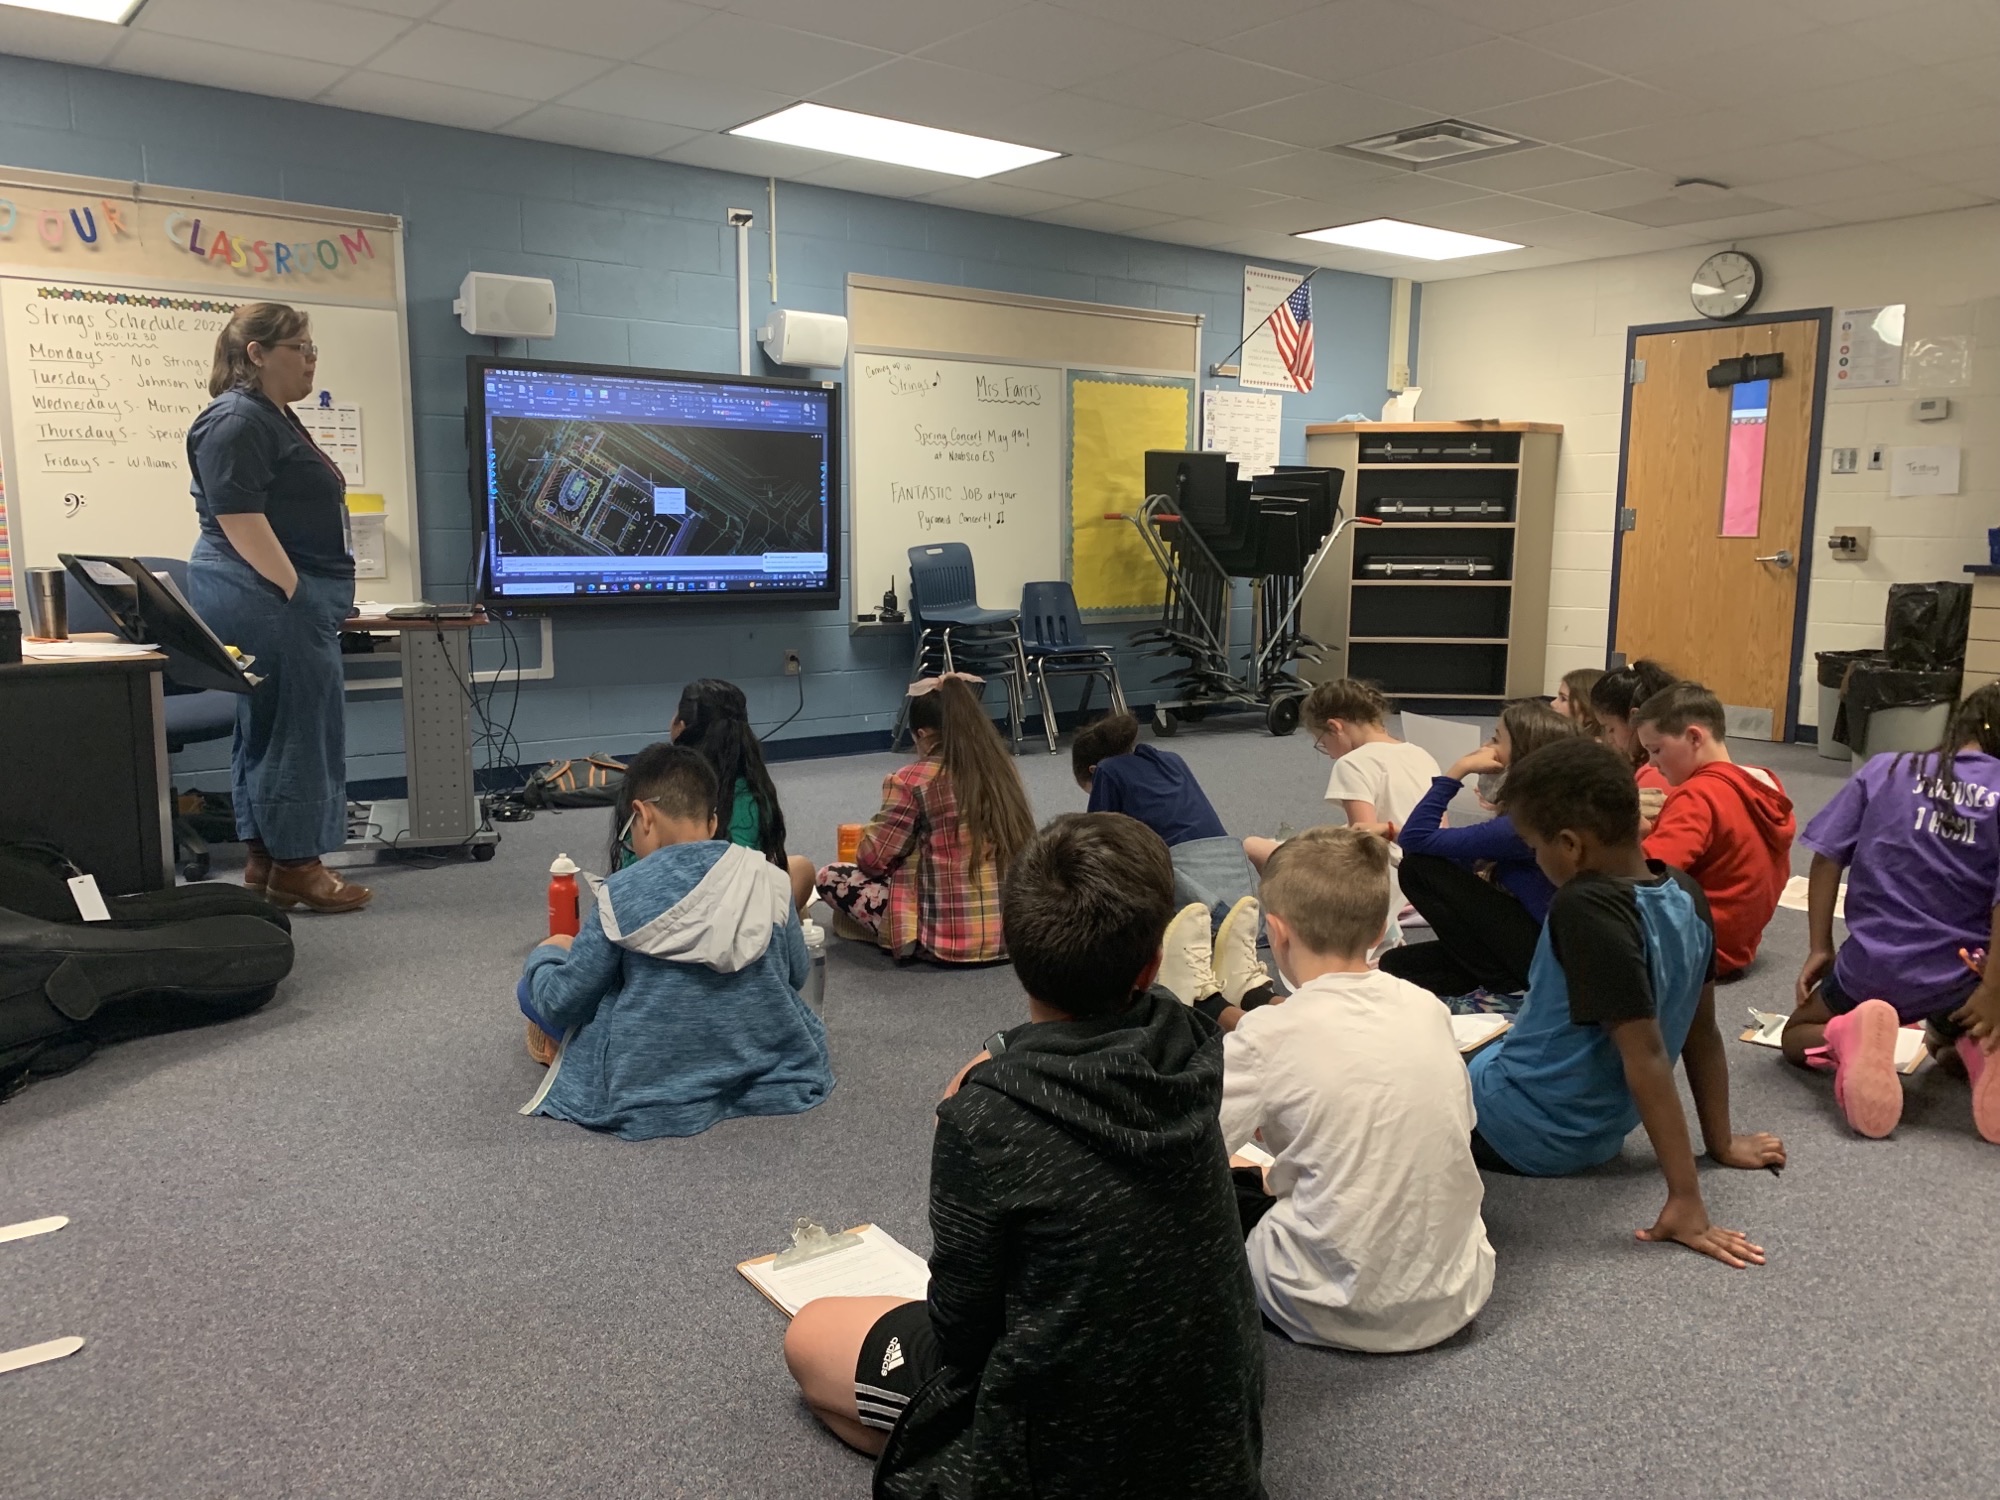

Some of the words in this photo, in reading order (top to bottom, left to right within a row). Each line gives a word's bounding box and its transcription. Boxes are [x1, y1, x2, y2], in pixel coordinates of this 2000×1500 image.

[37, 199, 127, 243] OUR
[164, 211, 375, 276] CLASSROOM
[26, 304, 94, 338] Strings
[105, 308, 188, 332] Schedule
[29, 343, 104, 369] Mondays
[131, 354, 151, 367] No
[163, 355, 209, 375] Strings
[29, 369, 110, 397] Tuesdays
[137, 374, 188, 389] Johnson
[889, 375, 929, 397] Strings
[1004, 376, 1041, 400] Farris
[37, 423, 128, 446] Thursdays
[147, 424, 189, 444] Speigh
[914, 424, 948, 449] Spring
[951, 427, 982, 441] Concert
[988, 429, 1008, 452] May
[44, 453, 100, 472] Fridays
[127, 455, 178, 469] Williams
[934, 451, 942, 460] at
[983, 450, 995, 462] ES
[891, 481, 952, 504] FANTASTIC
[960, 486, 983, 501] JOB
[998, 492, 1018, 505] your
[881, 1336, 899, 1377] adidas
